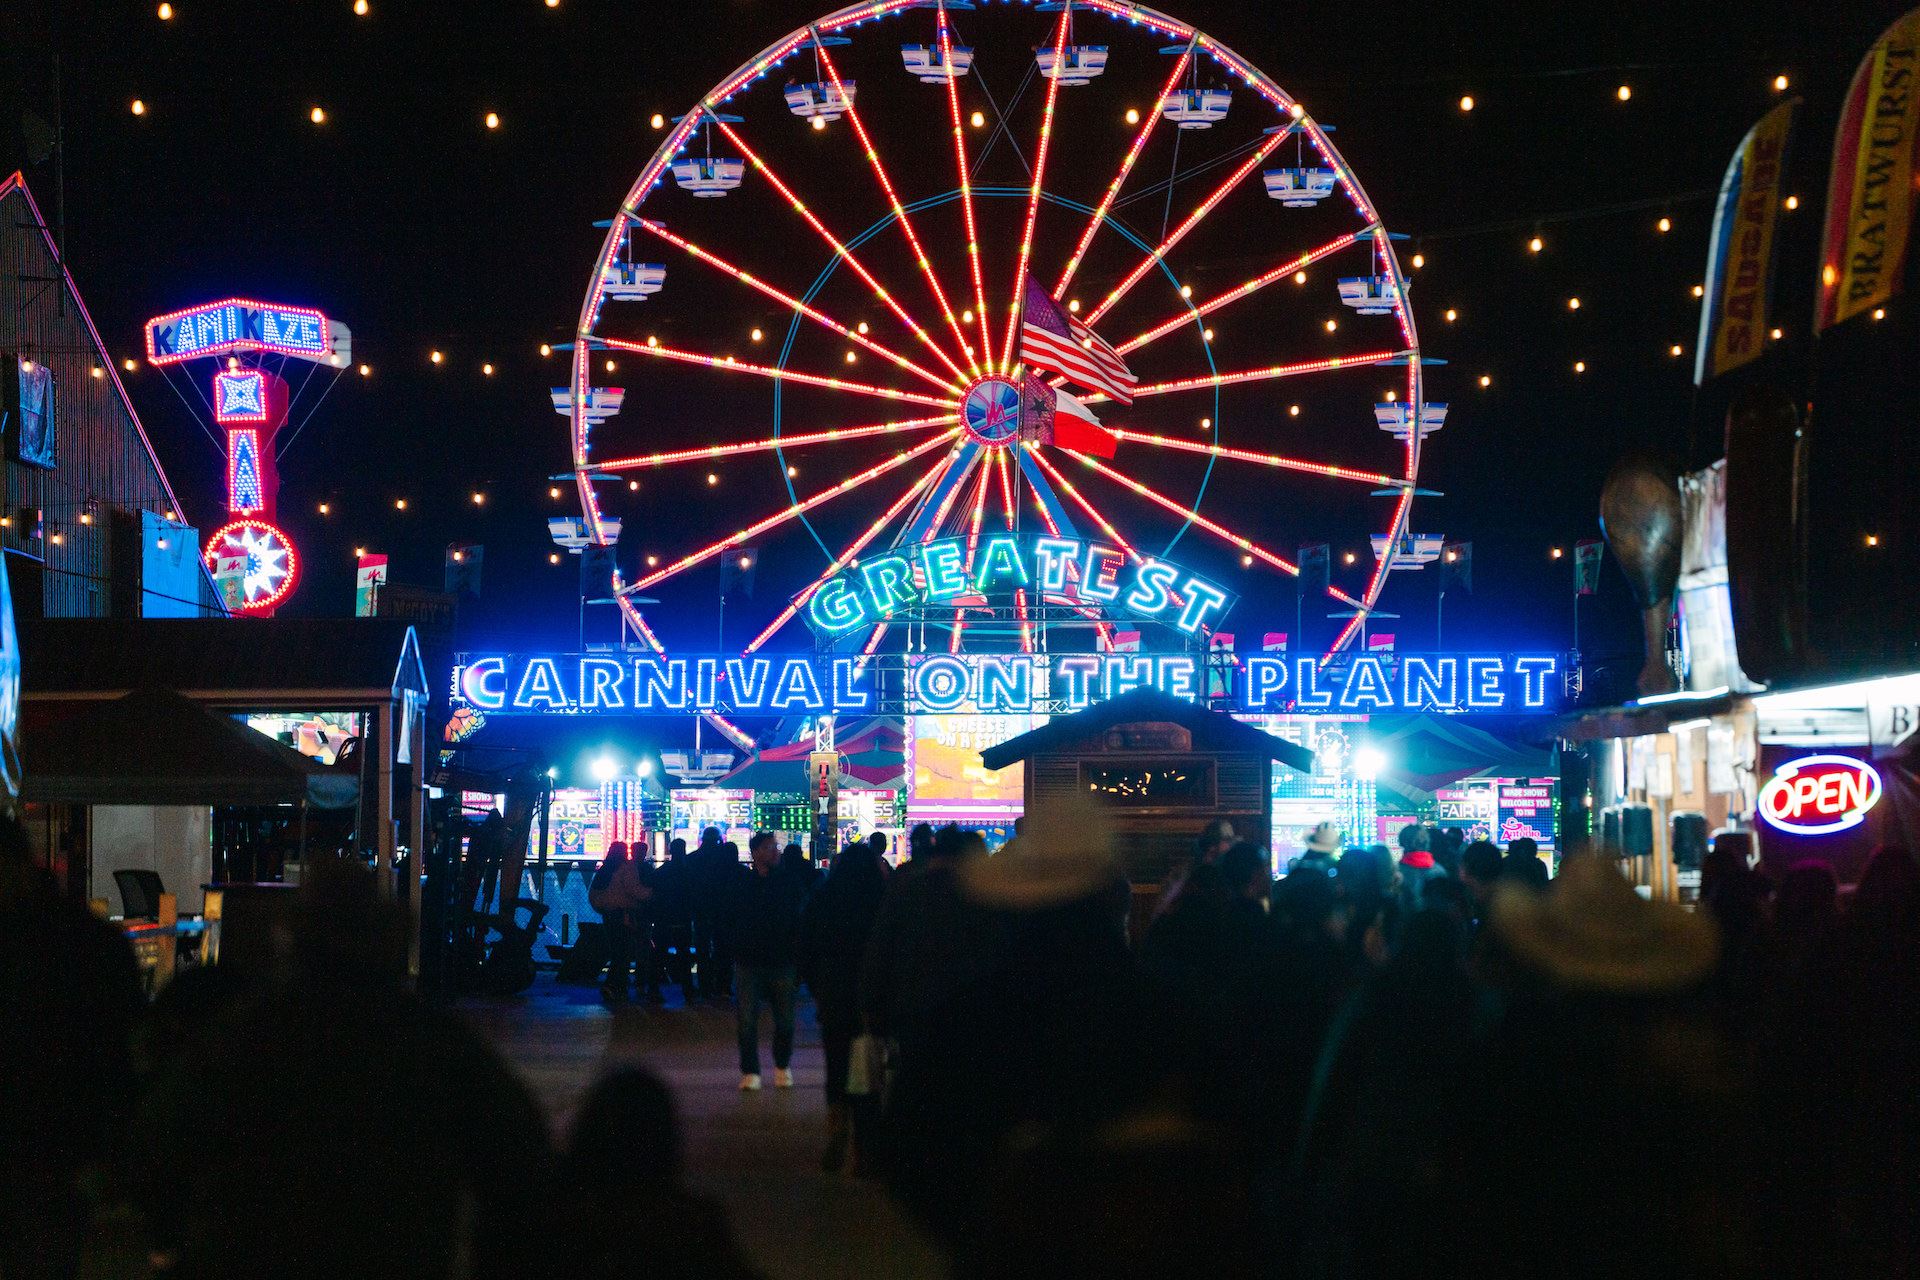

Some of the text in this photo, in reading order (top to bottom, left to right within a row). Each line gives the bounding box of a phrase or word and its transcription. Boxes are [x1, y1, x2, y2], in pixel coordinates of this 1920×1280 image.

[1849, 42, 1916, 303] BRATWURST
[153, 305, 321, 357] KAMIKAZE
[809, 537, 1227, 633] GREATEST
[461, 656, 1556, 711] CARNIVAL ON THE PLANET
[1439, 803, 1475, 818] FAIR
[1764, 770, 1869, 819] OPEN
